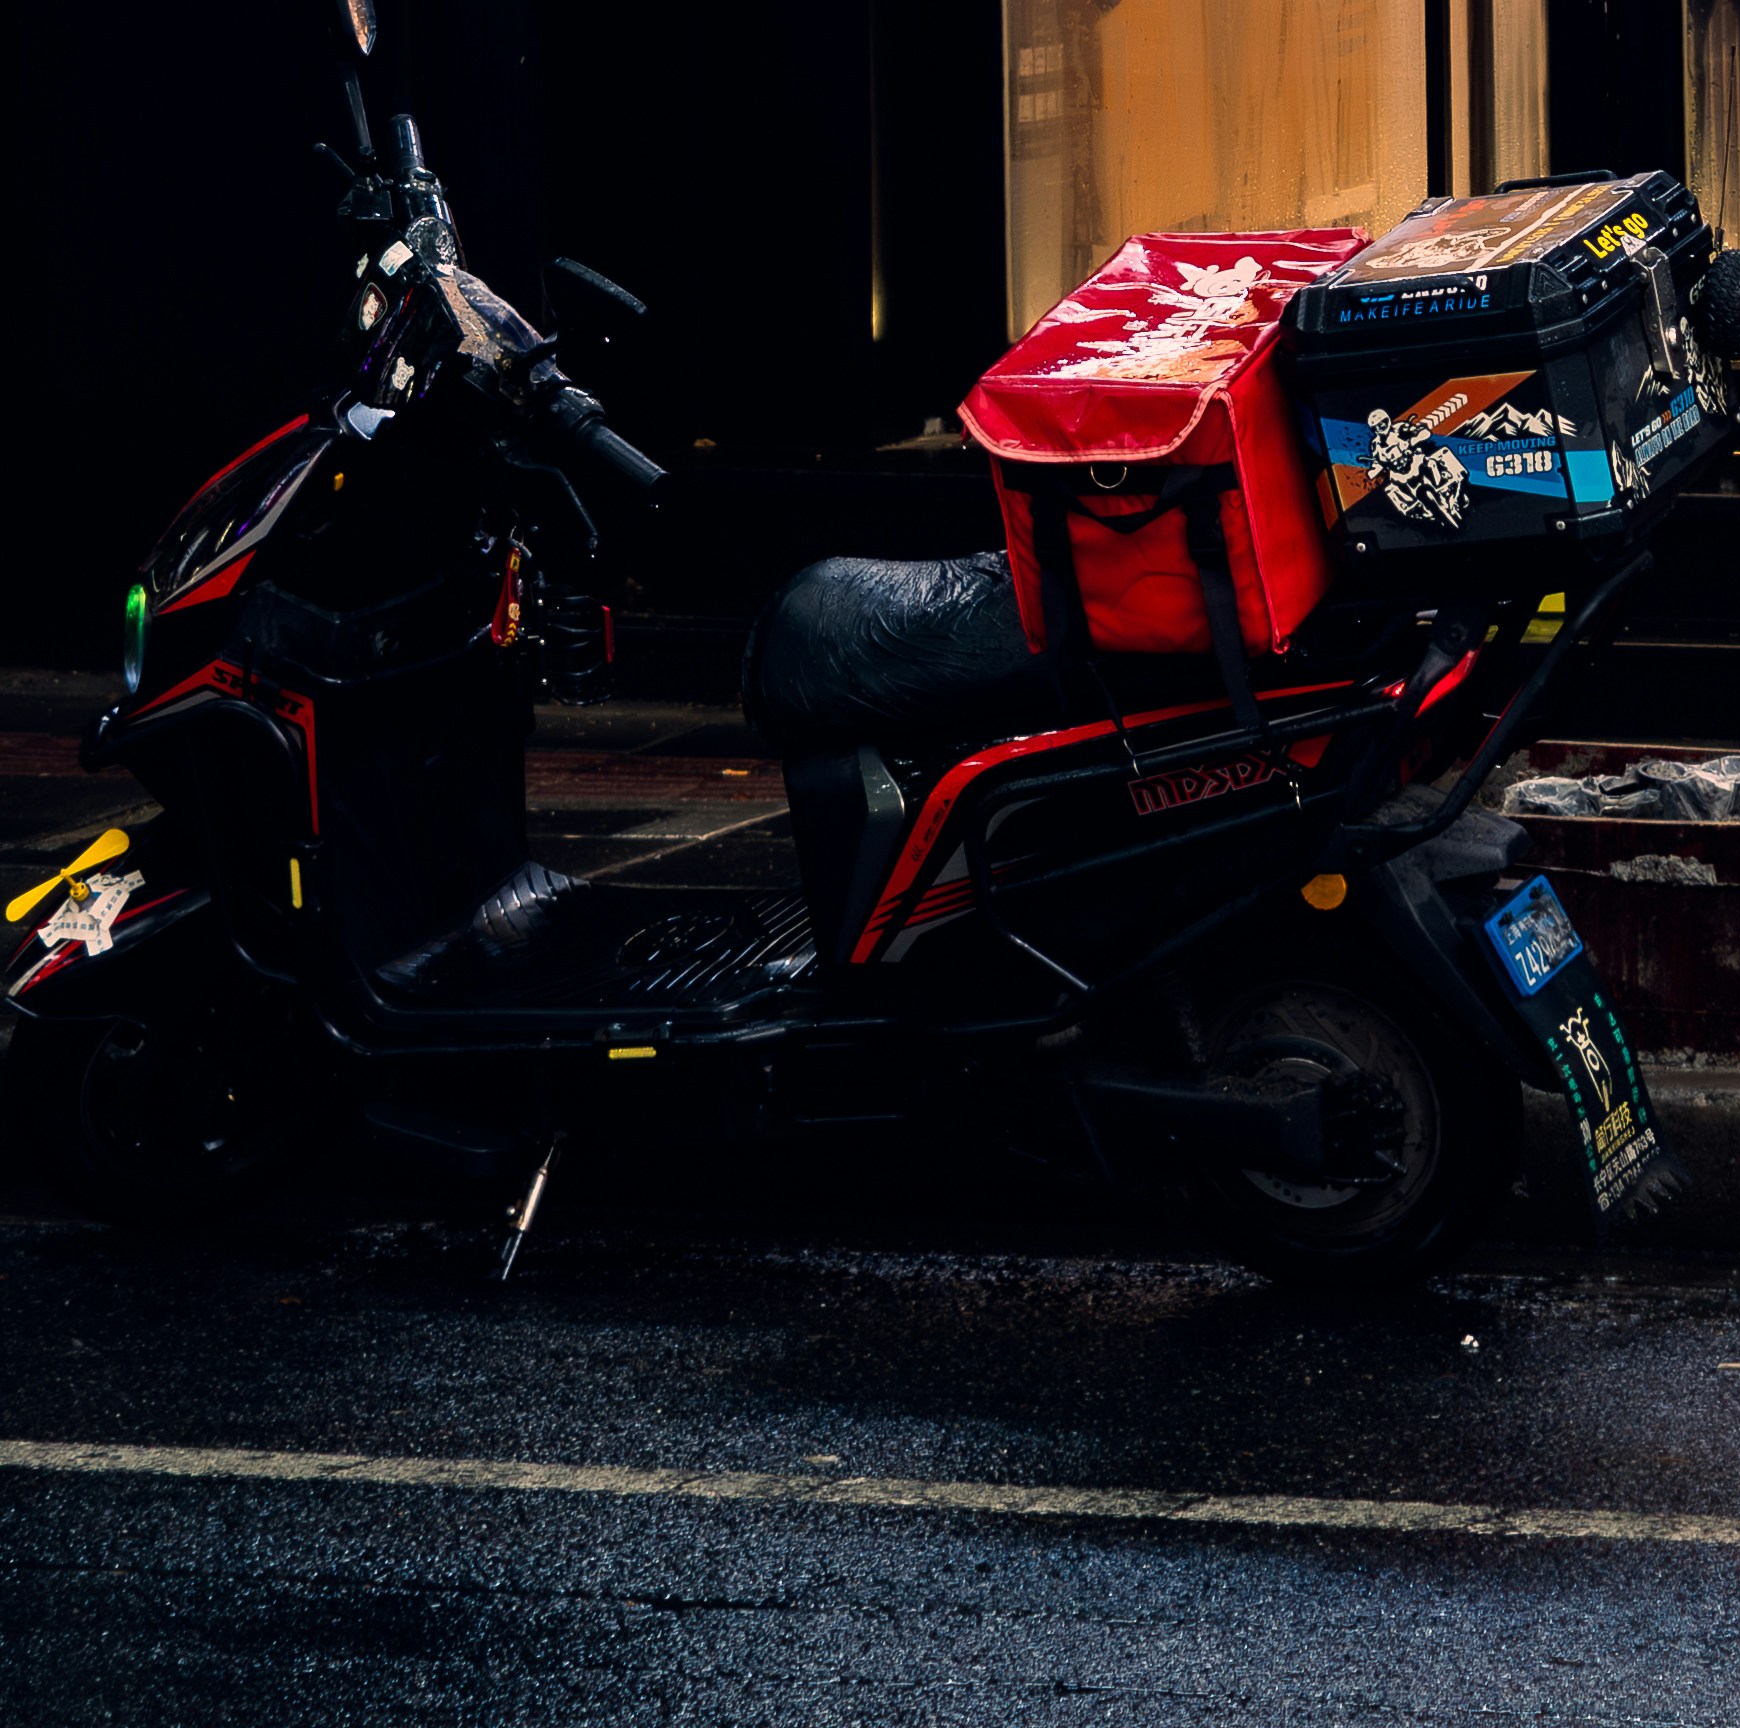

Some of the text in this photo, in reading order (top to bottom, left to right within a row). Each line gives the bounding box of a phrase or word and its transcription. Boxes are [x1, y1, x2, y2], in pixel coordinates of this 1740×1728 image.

[1583, 213, 1649, 259] Let's go
[1458, 436, 1557, 455] KEEP MOVING
[1486, 450, 1553, 478] G318
